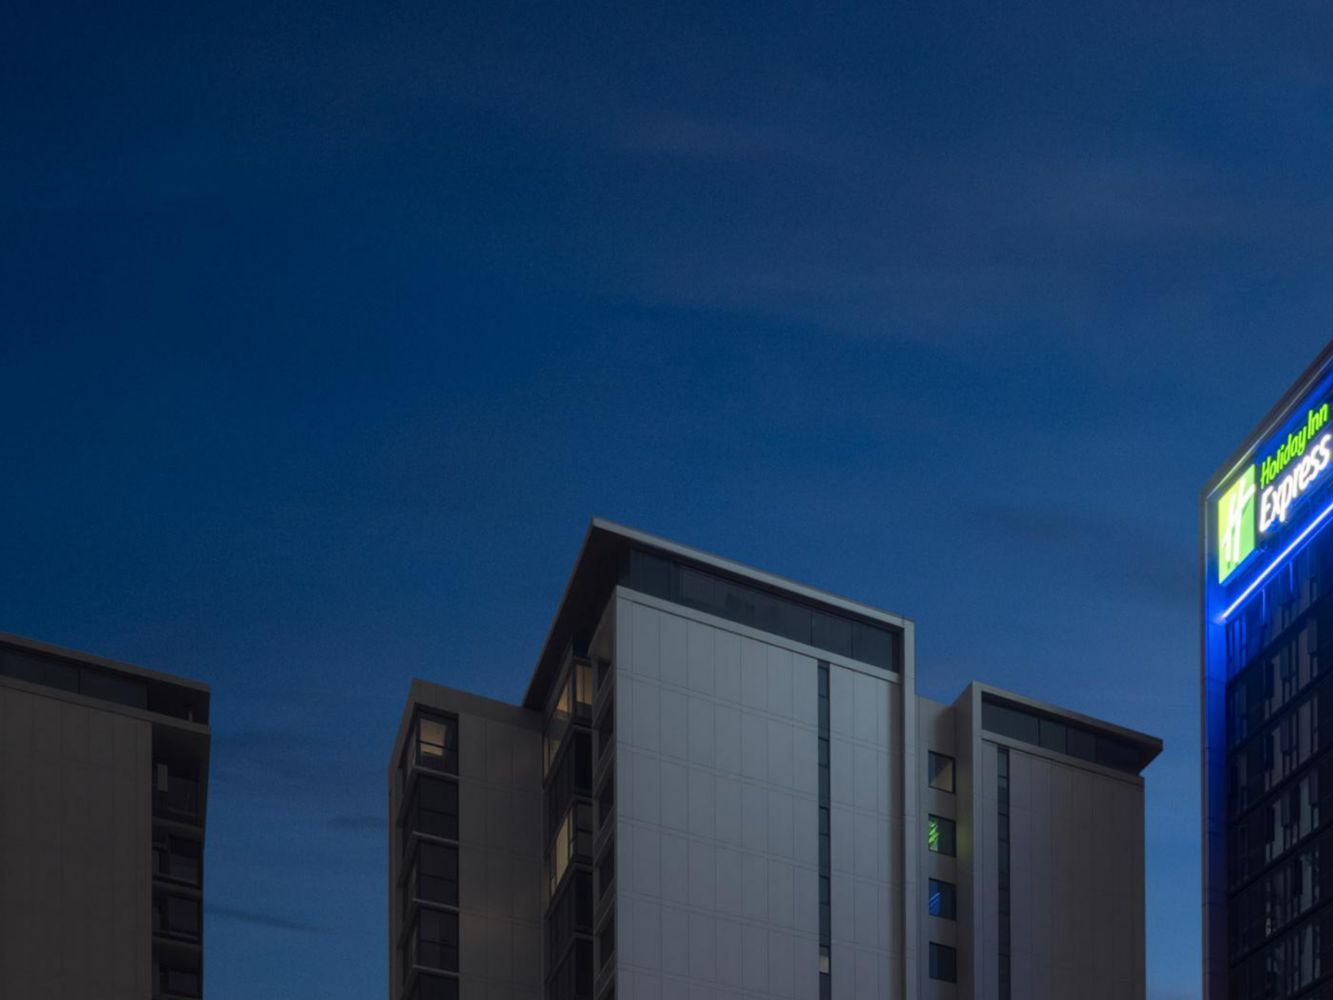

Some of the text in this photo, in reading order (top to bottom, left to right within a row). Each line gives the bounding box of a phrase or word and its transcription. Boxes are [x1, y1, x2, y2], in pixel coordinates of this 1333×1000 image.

[1259, 434, 1332, 533] Express
[1260, 403, 1330, 489] Holiday Inn
